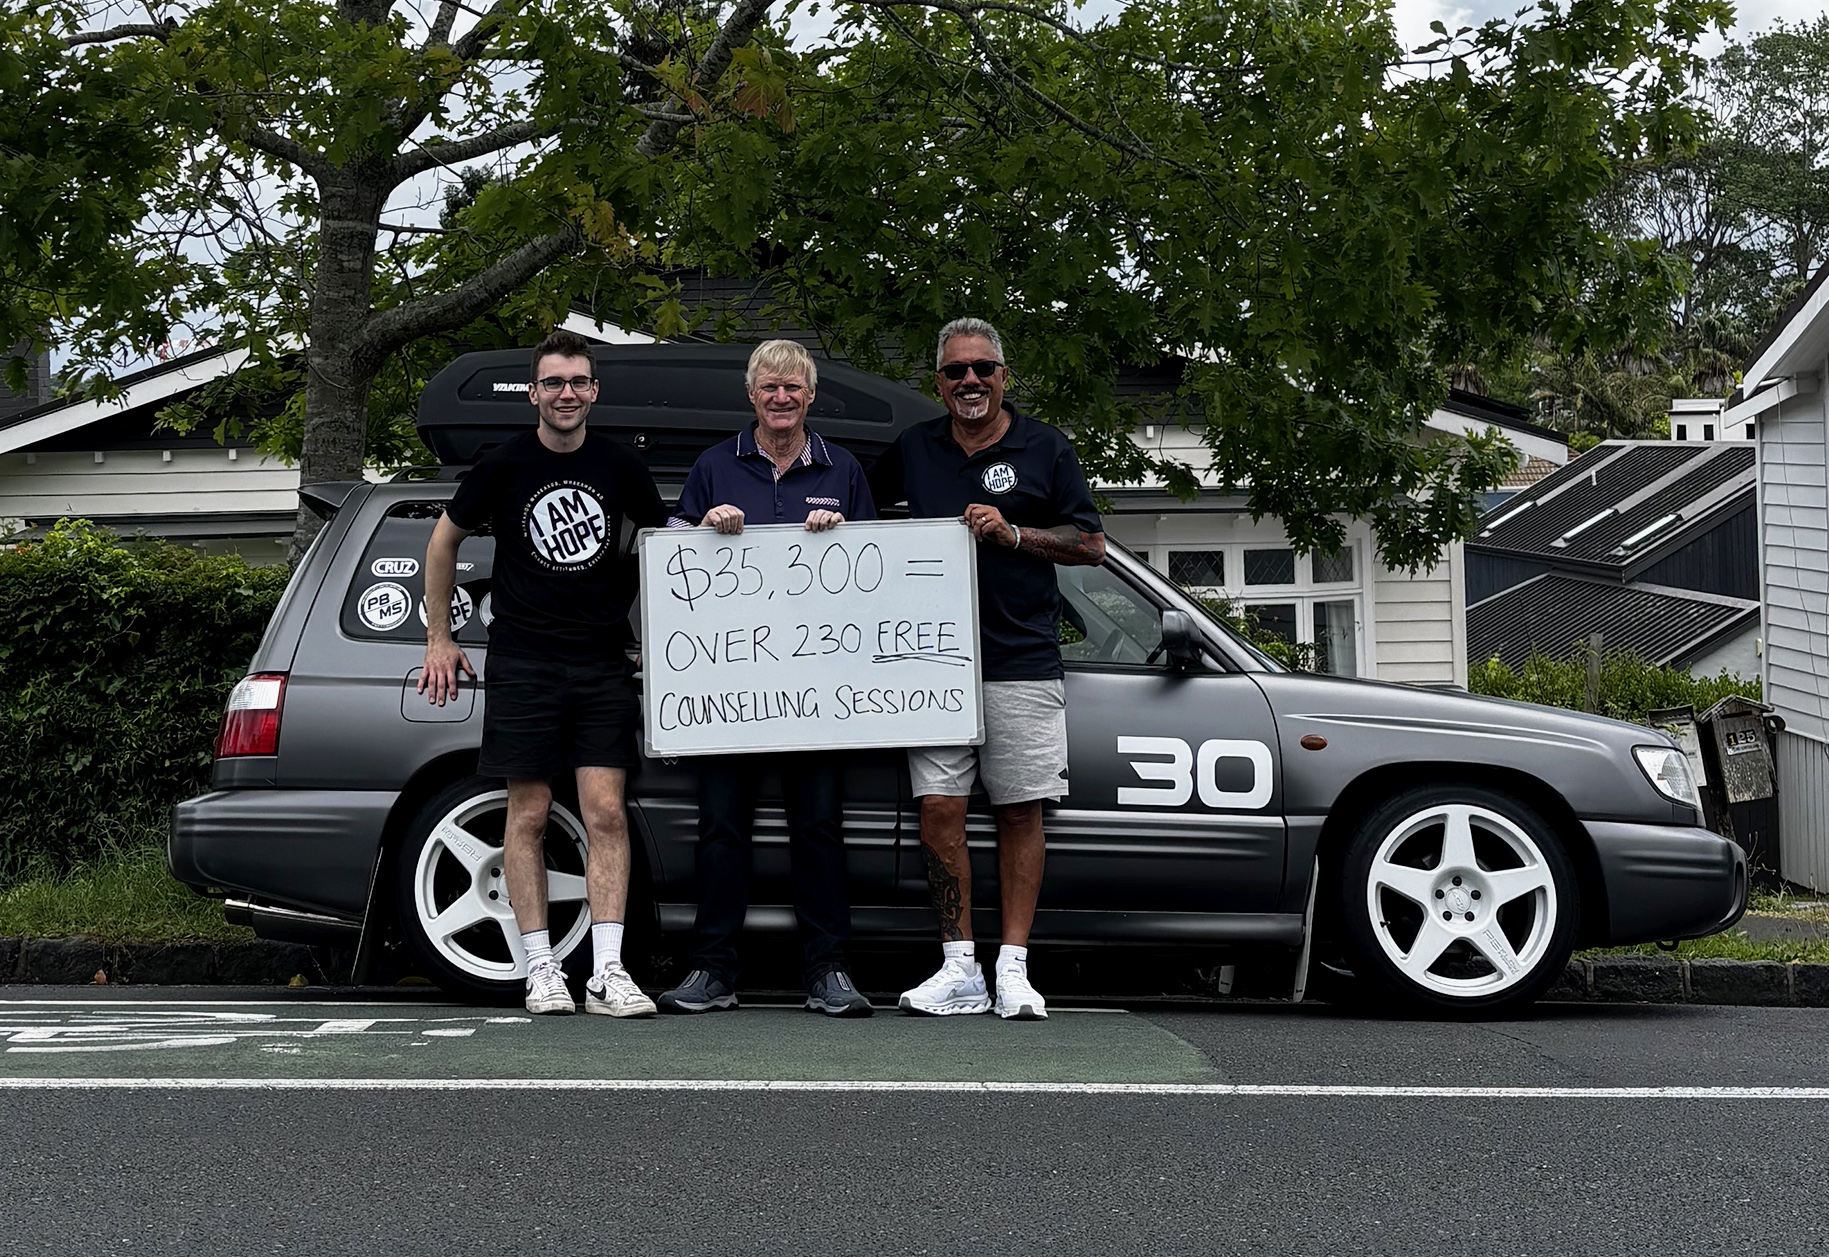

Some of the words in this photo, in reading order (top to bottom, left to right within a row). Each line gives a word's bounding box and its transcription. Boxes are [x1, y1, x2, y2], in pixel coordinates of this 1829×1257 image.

[493, 383, 530, 391] YAKIM
[993, 466, 1009, 478] AM
[989, 476, 1013, 490] HOPE
[531, 512, 545, 538] I
[547, 490, 589, 532] AM
[542, 514, 603, 562] HOPE
[375, 561, 414, 574] CRUZ
[666, 543, 884, 611] $35,300
[368, 593, 390, 610] PB
[380, 602, 402, 620] MS
[665, 625, 780, 671] OVER
[792, 623, 862, 656] 230
[877, 620, 961, 653] FREE
[659, 687, 820, 731] COUNSELLING
[834, 684, 964, 720] SESSIONS
[1728, 731, 1756, 746] 125
[1117, 736, 1273, 809] 30
